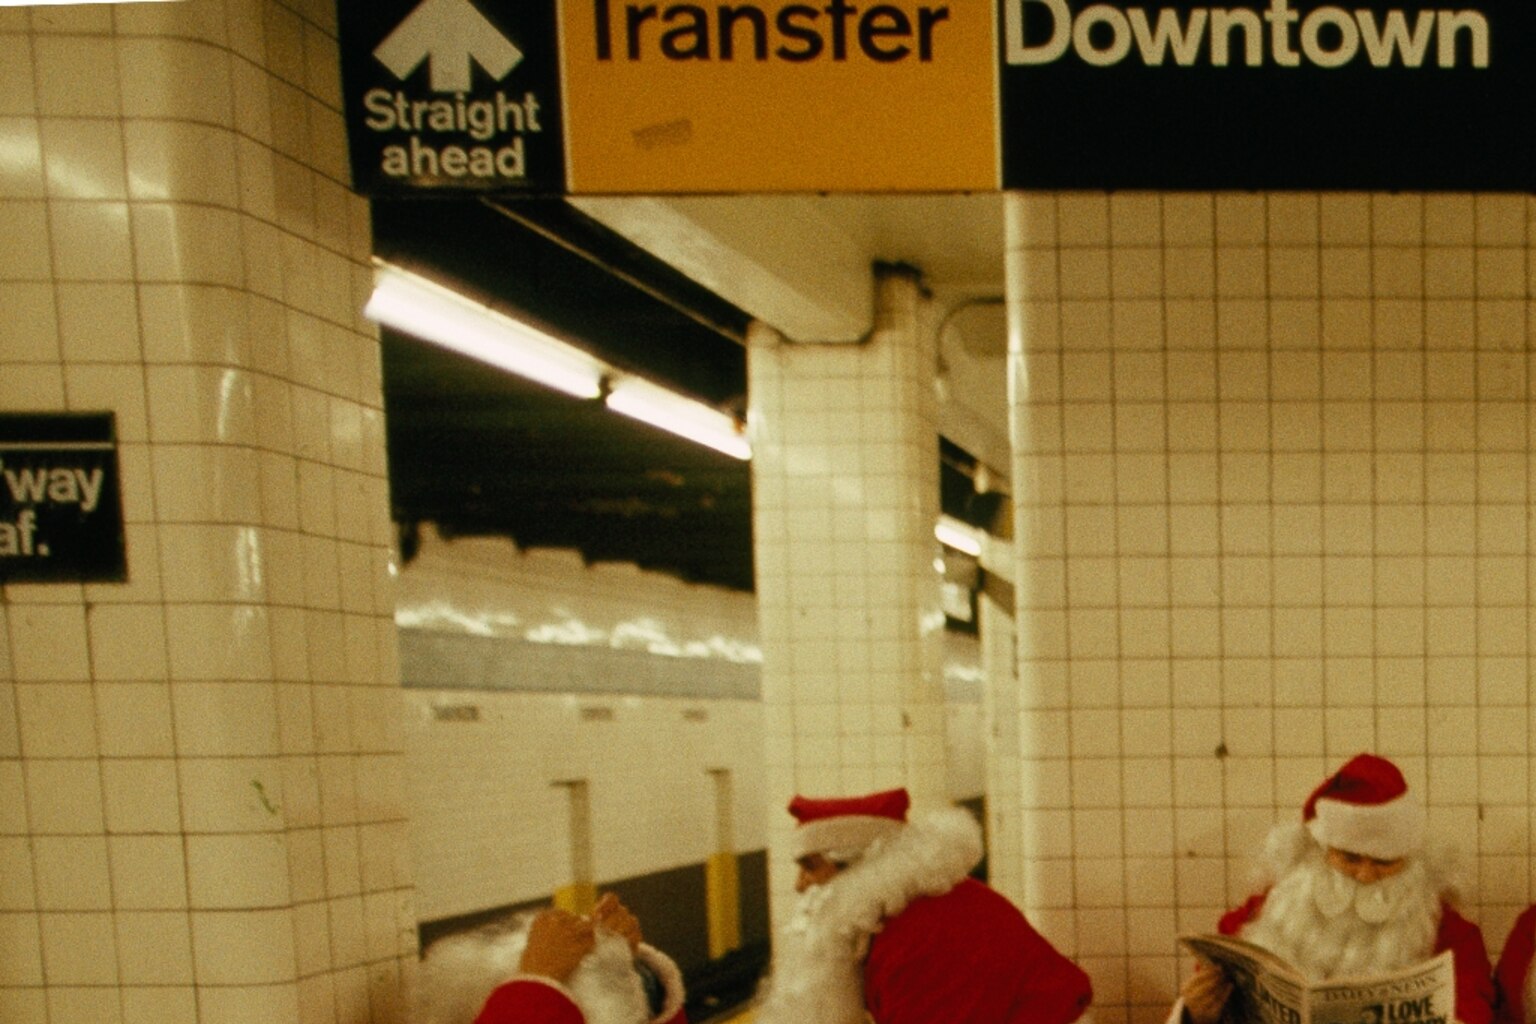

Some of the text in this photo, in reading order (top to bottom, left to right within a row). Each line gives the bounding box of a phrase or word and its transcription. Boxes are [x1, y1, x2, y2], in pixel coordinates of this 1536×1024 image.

[594, 0, 950, 62] Transfer
[1005, 0, 1490, 69] Downtown
[363, 87, 542, 141] Straight
[382, 136, 525, 177] ahead
[1388, 996, 1434, 1021] LOVE
